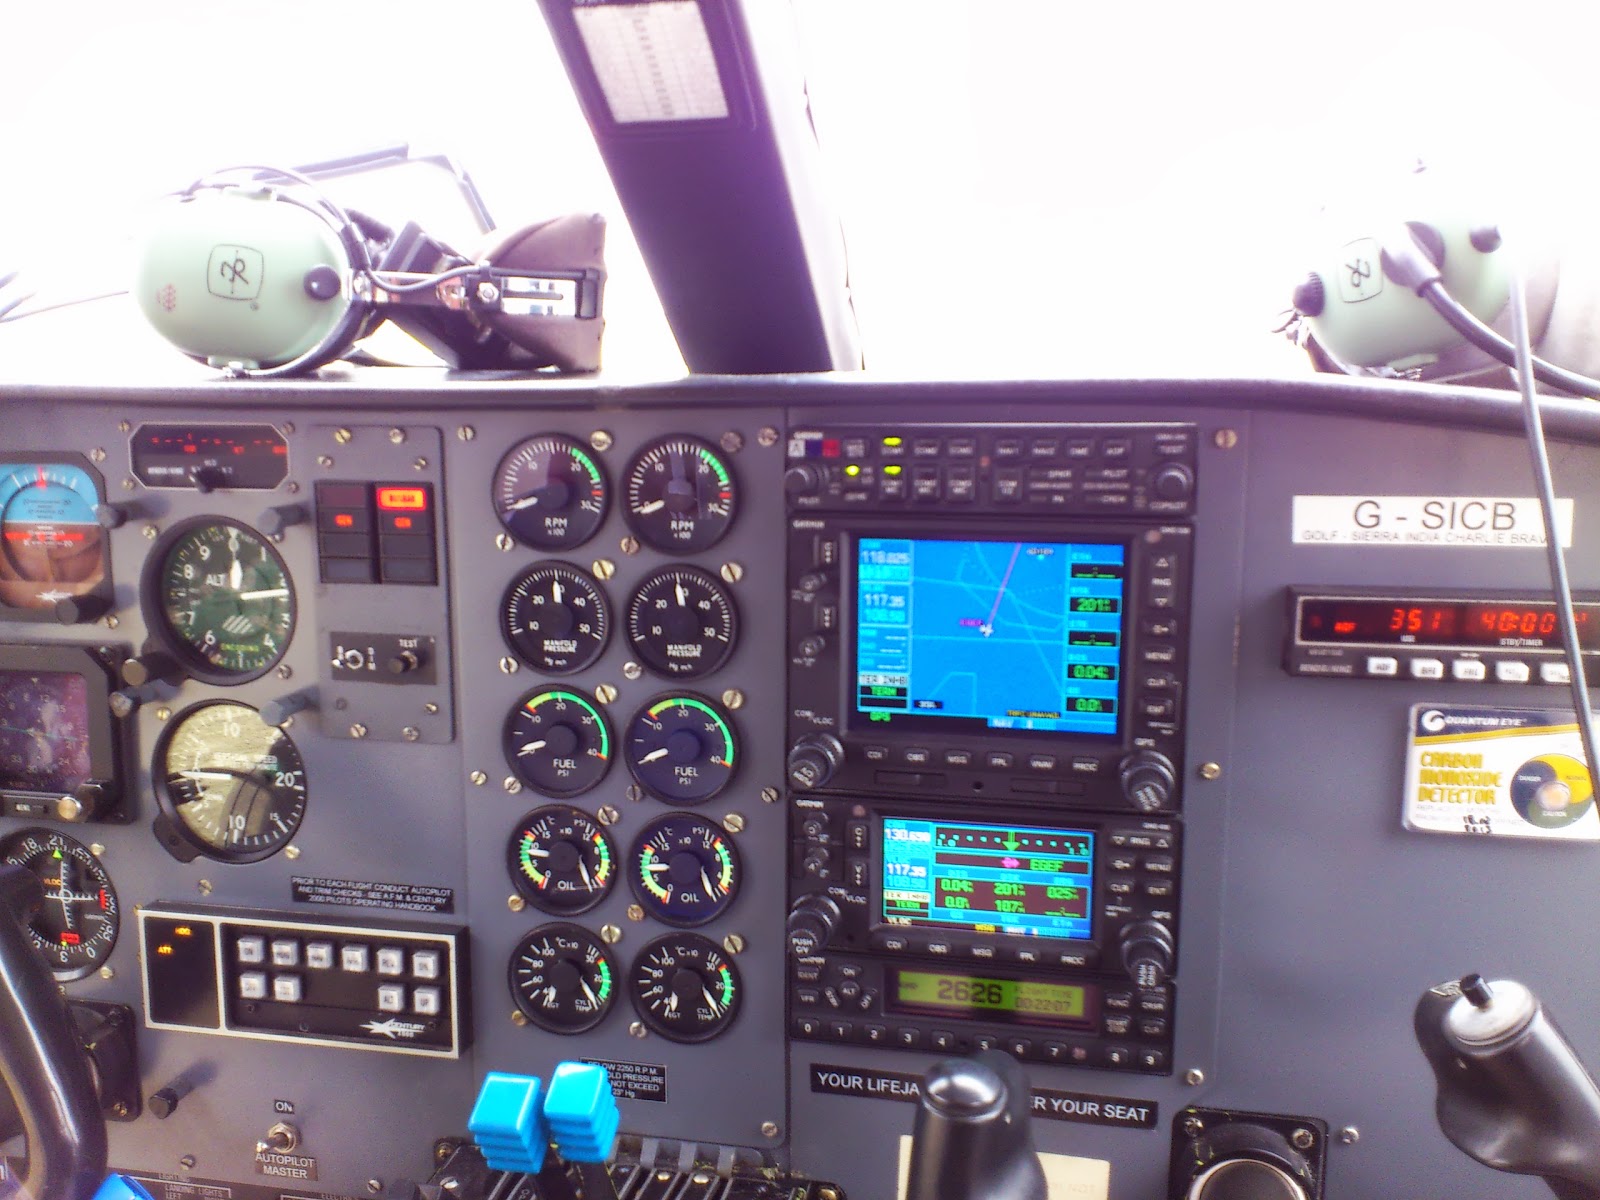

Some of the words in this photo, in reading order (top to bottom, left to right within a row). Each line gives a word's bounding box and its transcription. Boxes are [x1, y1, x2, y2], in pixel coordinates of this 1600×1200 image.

[654, 462, 665, 473] 10
[1354, 500, 1381, 529] G
[1422, 501, 1516, 531] SICB
[544, 517, 568, 528] RPM
[670, 520, 694, 531] RPM
[1303, 530, 1338, 541] GOLF
[1352, 531, 1399, 542] SIERRA
[1405, 531, 1440, 542] INDIA
[1446, 532, 1506, 543] CHARLIE
[1510, 533, 1548, 544] BRAV
[200, 545, 211, 560] 9
[184, 564, 194, 580] 8
[205, 574, 226, 586] ALT
[1151, 578, 1172, 587] RNG
[532, 594, 545, 605] 20
[573, 596, 586, 607] 40
[655, 599, 668, 610] 20
[697, 600, 711, 610] 40
[185, 611, 196, 626] 7
[1389, 608, 1441, 632] 351
[1481, 610, 1556, 633] 40:00
[529, 620, 540, 631] 10
[579, 623, 591, 634] 50
[652, 625, 662, 636] 10
[703, 626, 716, 637] 50
[205, 630, 216, 645] 6
[399, 638, 419, 648] TEST
[666, 644, 702, 652] MANIFOLD
[1145, 651, 1173, 661] MENU
[555, 702, 567, 711] 20
[677, 709, 689, 717] 20
[531, 715, 542, 724] 10
[1445, 716, 1499, 726] QUANTUM
[652, 722, 663, 731] 10
[704, 722, 716, 732] 30
[586, 747, 598, 757] 40
[866, 750, 883, 760] CDI
[906, 752, 925, 762] OBS
[552, 758, 577, 769] FUEL
[709, 755, 722, 765] 40
[1420, 752, 1483, 769] CARBON
[557, 769, 570, 777] PSI
[674, 766, 699, 777] FUEL
[275, 771, 295, 787] 20
[678, 777, 692, 785] PSI
[1419, 769, 1503, 787] MONOXIDE
[1418, 787, 1497, 804] DETECTOR
[229, 815, 246, 830] 10
[573, 818, 586, 827] PSI
[541, 831, 552, 839] 15
[691, 826, 706, 835] PSI
[855, 827, 862, 835] C
[582, 833, 592, 842] 12
[702, 841, 711, 849] 12
[887, 863, 927, 878] 117.35
[292, 877, 315, 885] PRIOR
[315, 878, 326, 886] TO
[326, 879, 347, 888] EACH
[374, 883, 410, 893] CONDUCT
[411, 885, 452, 896] AUTOPILOT
[557, 880, 577, 891] OIL
[666, 883, 674, 892] 0
[1110, 883, 1131, 893] CLR
[298, 885, 314, 893] AND
[367, 891, 382, 899] SEE
[412, 895, 447, 905] CENTURY
[680, 892, 700, 903] OIL
[353, 897, 394, 909] OPERATING
[394, 901, 437, 912] HANDBOOK
[791, 937, 815, 946] PUSH
[886, 940, 902, 949] CDI
[158, 944, 174, 955] ATT
[541, 948, 556, 956] 100
[928, 943, 948, 953] OBS
[972, 948, 993, 958] MSG
[532, 959, 544, 968] 80
[660, 956, 675, 966] 100
[651, 969, 664, 978] 80
[842, 967, 856, 976] ON
[532, 975, 544, 983] 60
[652, 984, 664, 994] 60
[715, 981, 725, 991] 20
[842, 986, 856, 996] ALT
[937, 978, 1003, 1005] 2626
[574, 998, 587, 1006] CYL
[668, 1011, 681, 1019] EGT
[804, 1023, 812, 1033] 0
[838, 1026, 844, 1036] 1
[870, 1029, 879, 1040] 2
[904, 1033, 912, 1043] 3
[937, 1037, 946, 1047] 4
[1015, 1043, 1024, 1054] 6
[622, 1072, 665, 1084] PRESSURE
[610, 1080, 627, 1089] NOT
[627, 1081, 660, 1092] EXCEED
[816, 1072, 864, 1090] YOUR
[866, 1077, 921, 1096] LIFEJA
[276, 1101, 294, 1112] ON
[1049, 1097, 1100, 1117] YOUR
[1103, 1104, 1150, 1122] SEAT
[255, 1152, 316, 1168] AUTOPILOT
[263, 1165, 309, 1180] MASTER
